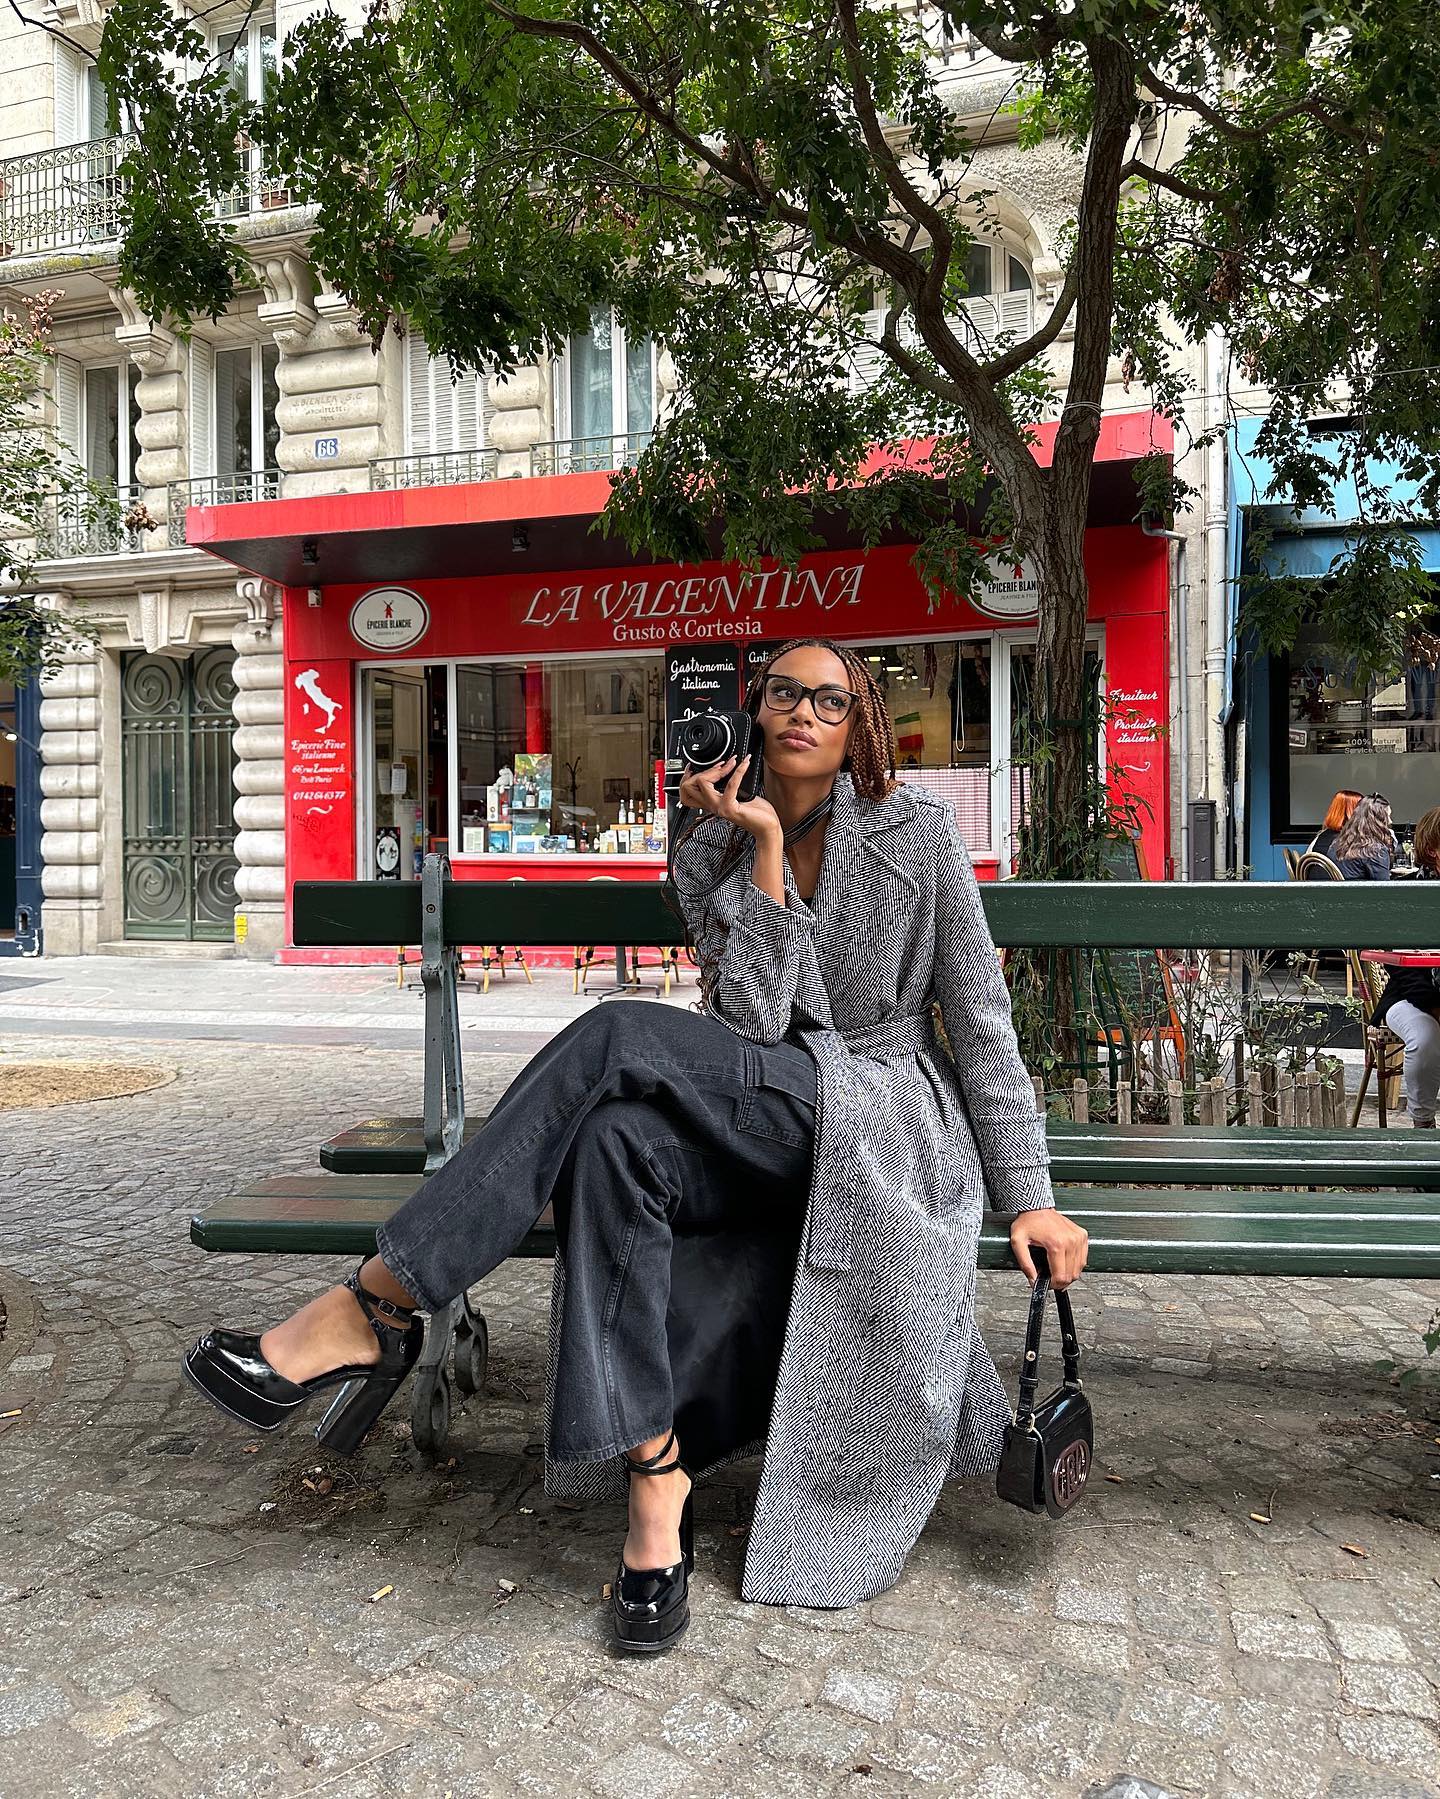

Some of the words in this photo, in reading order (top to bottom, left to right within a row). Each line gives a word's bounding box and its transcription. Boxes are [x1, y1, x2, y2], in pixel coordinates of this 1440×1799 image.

[317, 439, 336, 457] 66
[522, 585, 584, 627] LA
[594, 564, 865, 624] VALENTINA
[389, 619, 412, 629] BLANCHE
[613, 624, 665, 642] Gusto
[669, 621, 681, 639] &
[684, 616, 763, 638] Cortesia
[670, 657, 736, 681] Gastronomia
[681, 676, 721, 690] italiana
[1109, 688, 1159, 701] Traiteur
[1114, 717, 1157, 731] Produits
[324, 739, 346, 750] Fine
[1346, 738, 1372, 746] 100%
